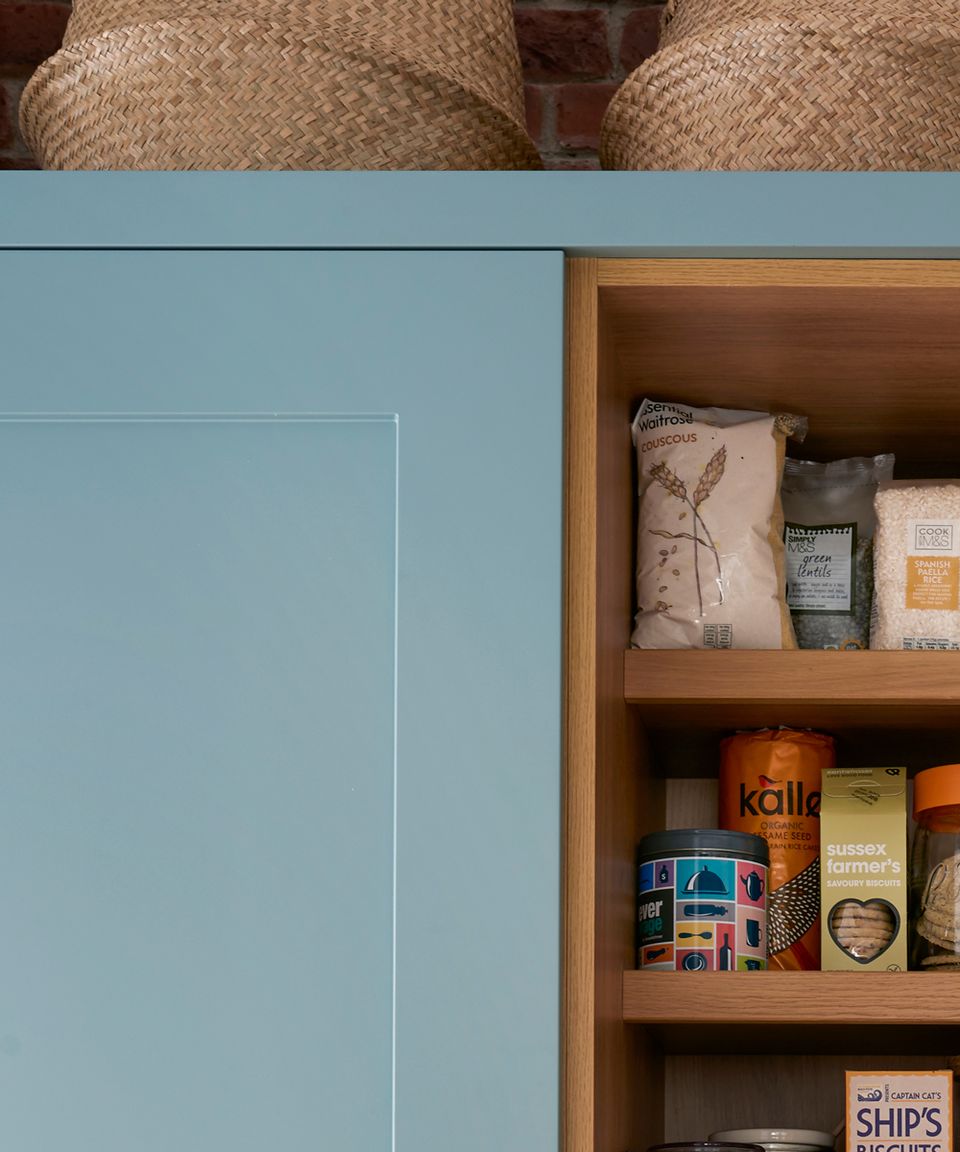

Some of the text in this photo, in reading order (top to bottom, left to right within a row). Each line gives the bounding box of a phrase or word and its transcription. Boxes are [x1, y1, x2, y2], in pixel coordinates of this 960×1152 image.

[641, 433, 698, 453] COUSCOUS
[918, 528, 949, 536] COOK
[802, 555, 832, 569] green
[914, 560, 951, 569] SPANISH
[797, 564, 832, 578] lentils
[917, 568, 949, 577] PAELLA
[923, 576, 943, 584] RICE
[760, 821, 804, 831] ORGANIC
[791, 832, 812, 841] SEED
[826, 844, 887, 856] sussex
[826, 859, 901, 873] farmer's
[826, 880, 864, 888] SAVOURY
[891, 1092, 920, 1100] CAPTAIN
[922, 1092, 942, 1100] CAT'S
[856, 1107, 942, 1137] SHIP'S
